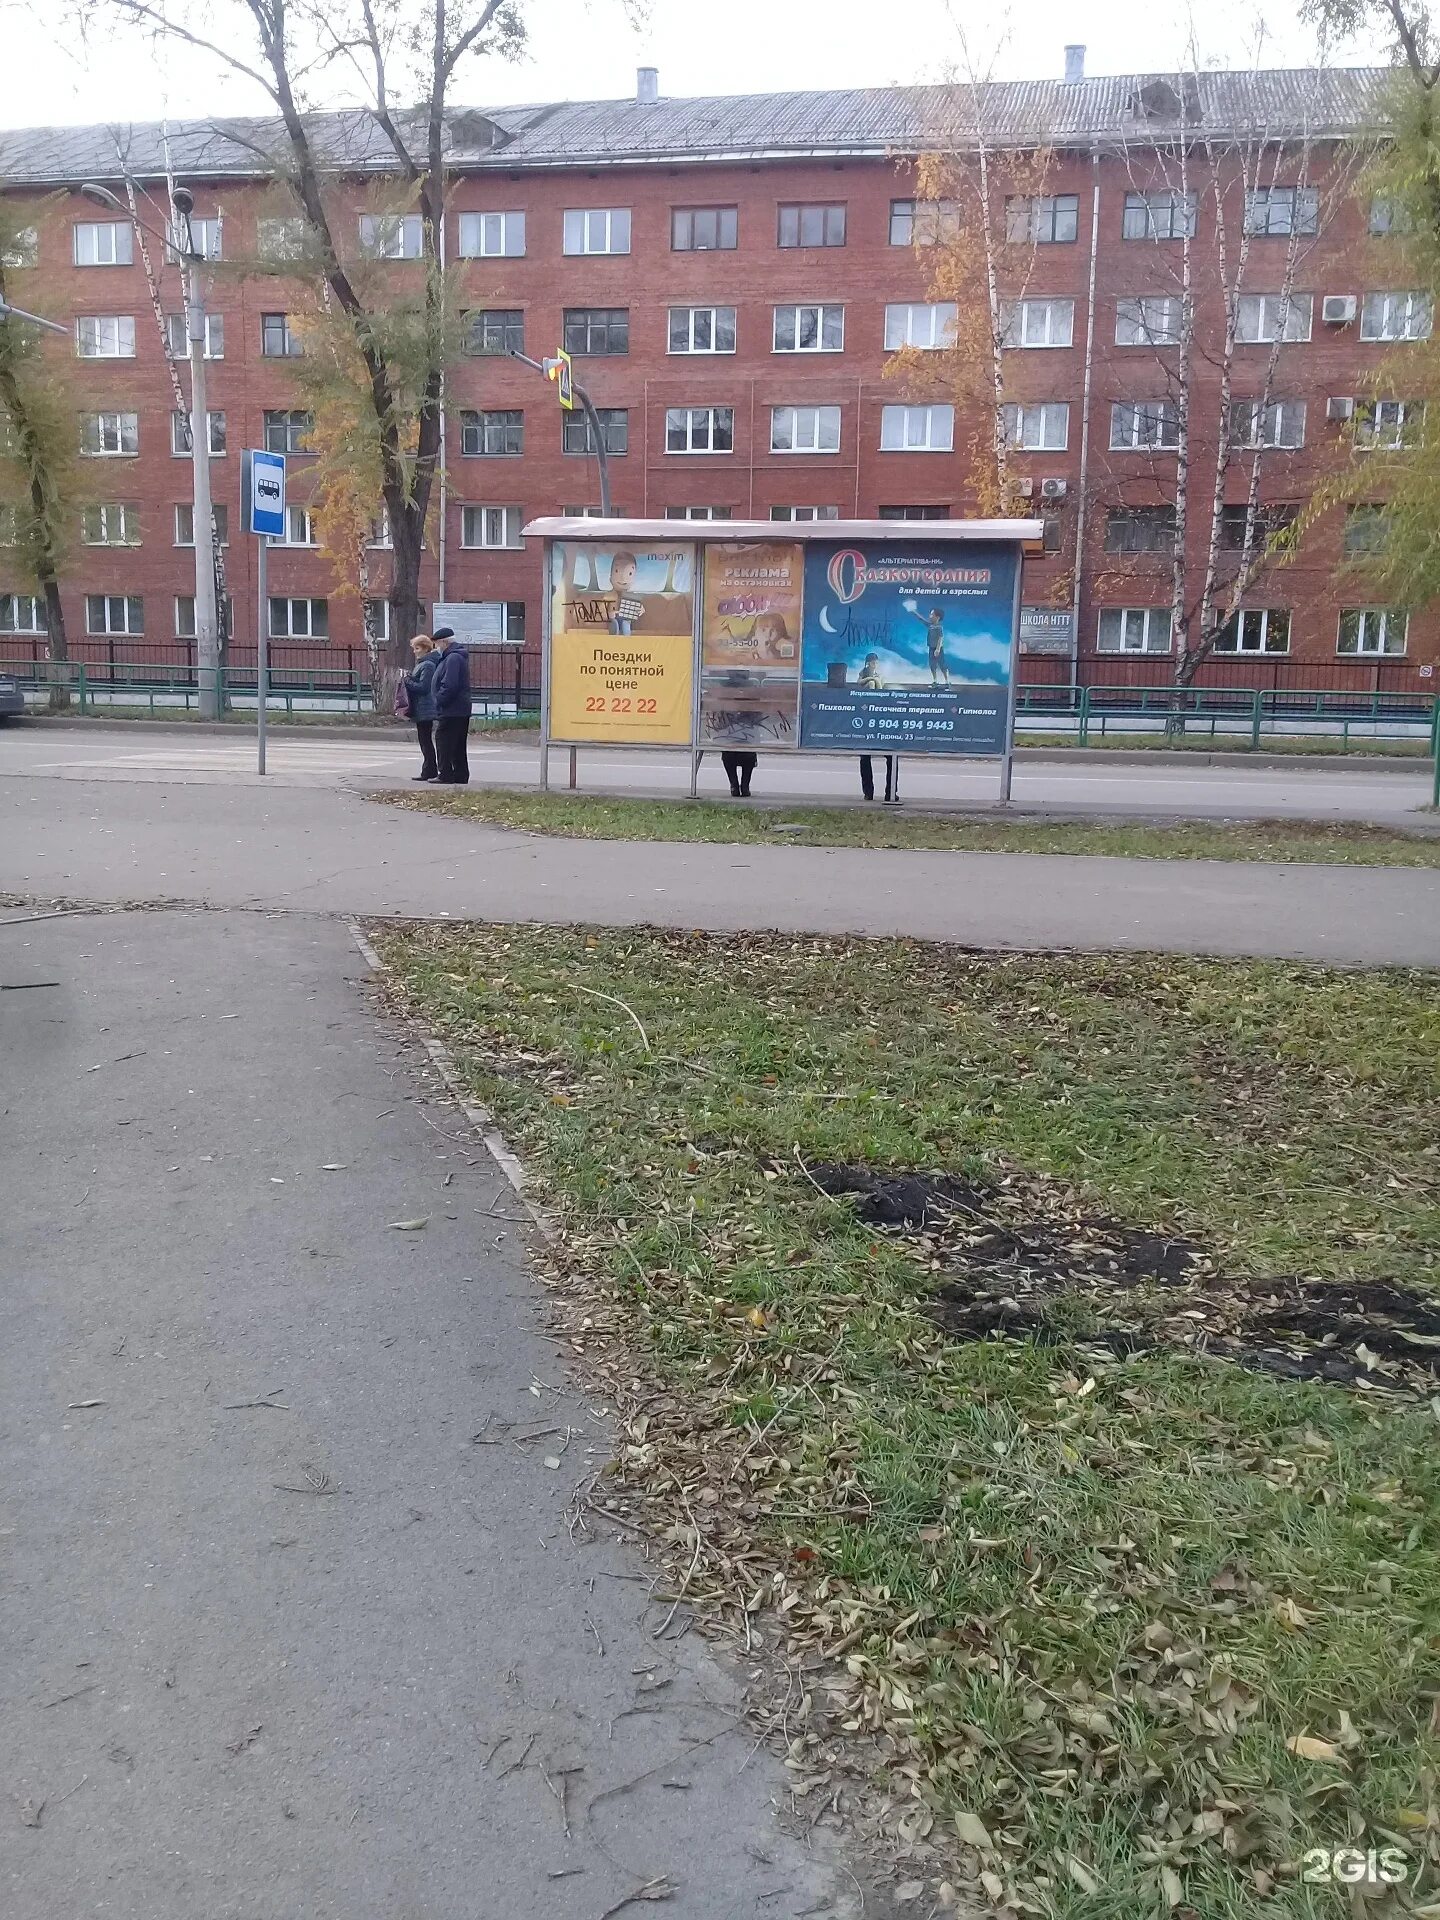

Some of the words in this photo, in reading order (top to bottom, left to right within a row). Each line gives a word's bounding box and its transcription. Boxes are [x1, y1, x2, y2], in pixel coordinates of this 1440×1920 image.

[827, 549, 991, 604] Сказкотерапия
[898, 586, 914, 594] для
[915, 587, 941, 595] детей
[593, 649, 652, 664] Поездки
[580, 665, 597, 675] по
[600, 665, 664, 677] понятной
[605, 680, 638, 691] цене
[586, 697, 606, 712] 22
[611, 698, 632, 713] 22
[637, 698, 657, 713] 22
[818, 703, 856, 711] Психолог
[868, 705, 907, 713] Песочная
[908, 707, 945, 715] терапия
[958, 707, 997, 716] Гипнолог
[868, 719, 876, 728] 8
[878, 719, 899, 729] 904
[902, 720, 923, 730] 994
[926, 721, 954, 731] 9443
[904, 733, 914, 741] 23
